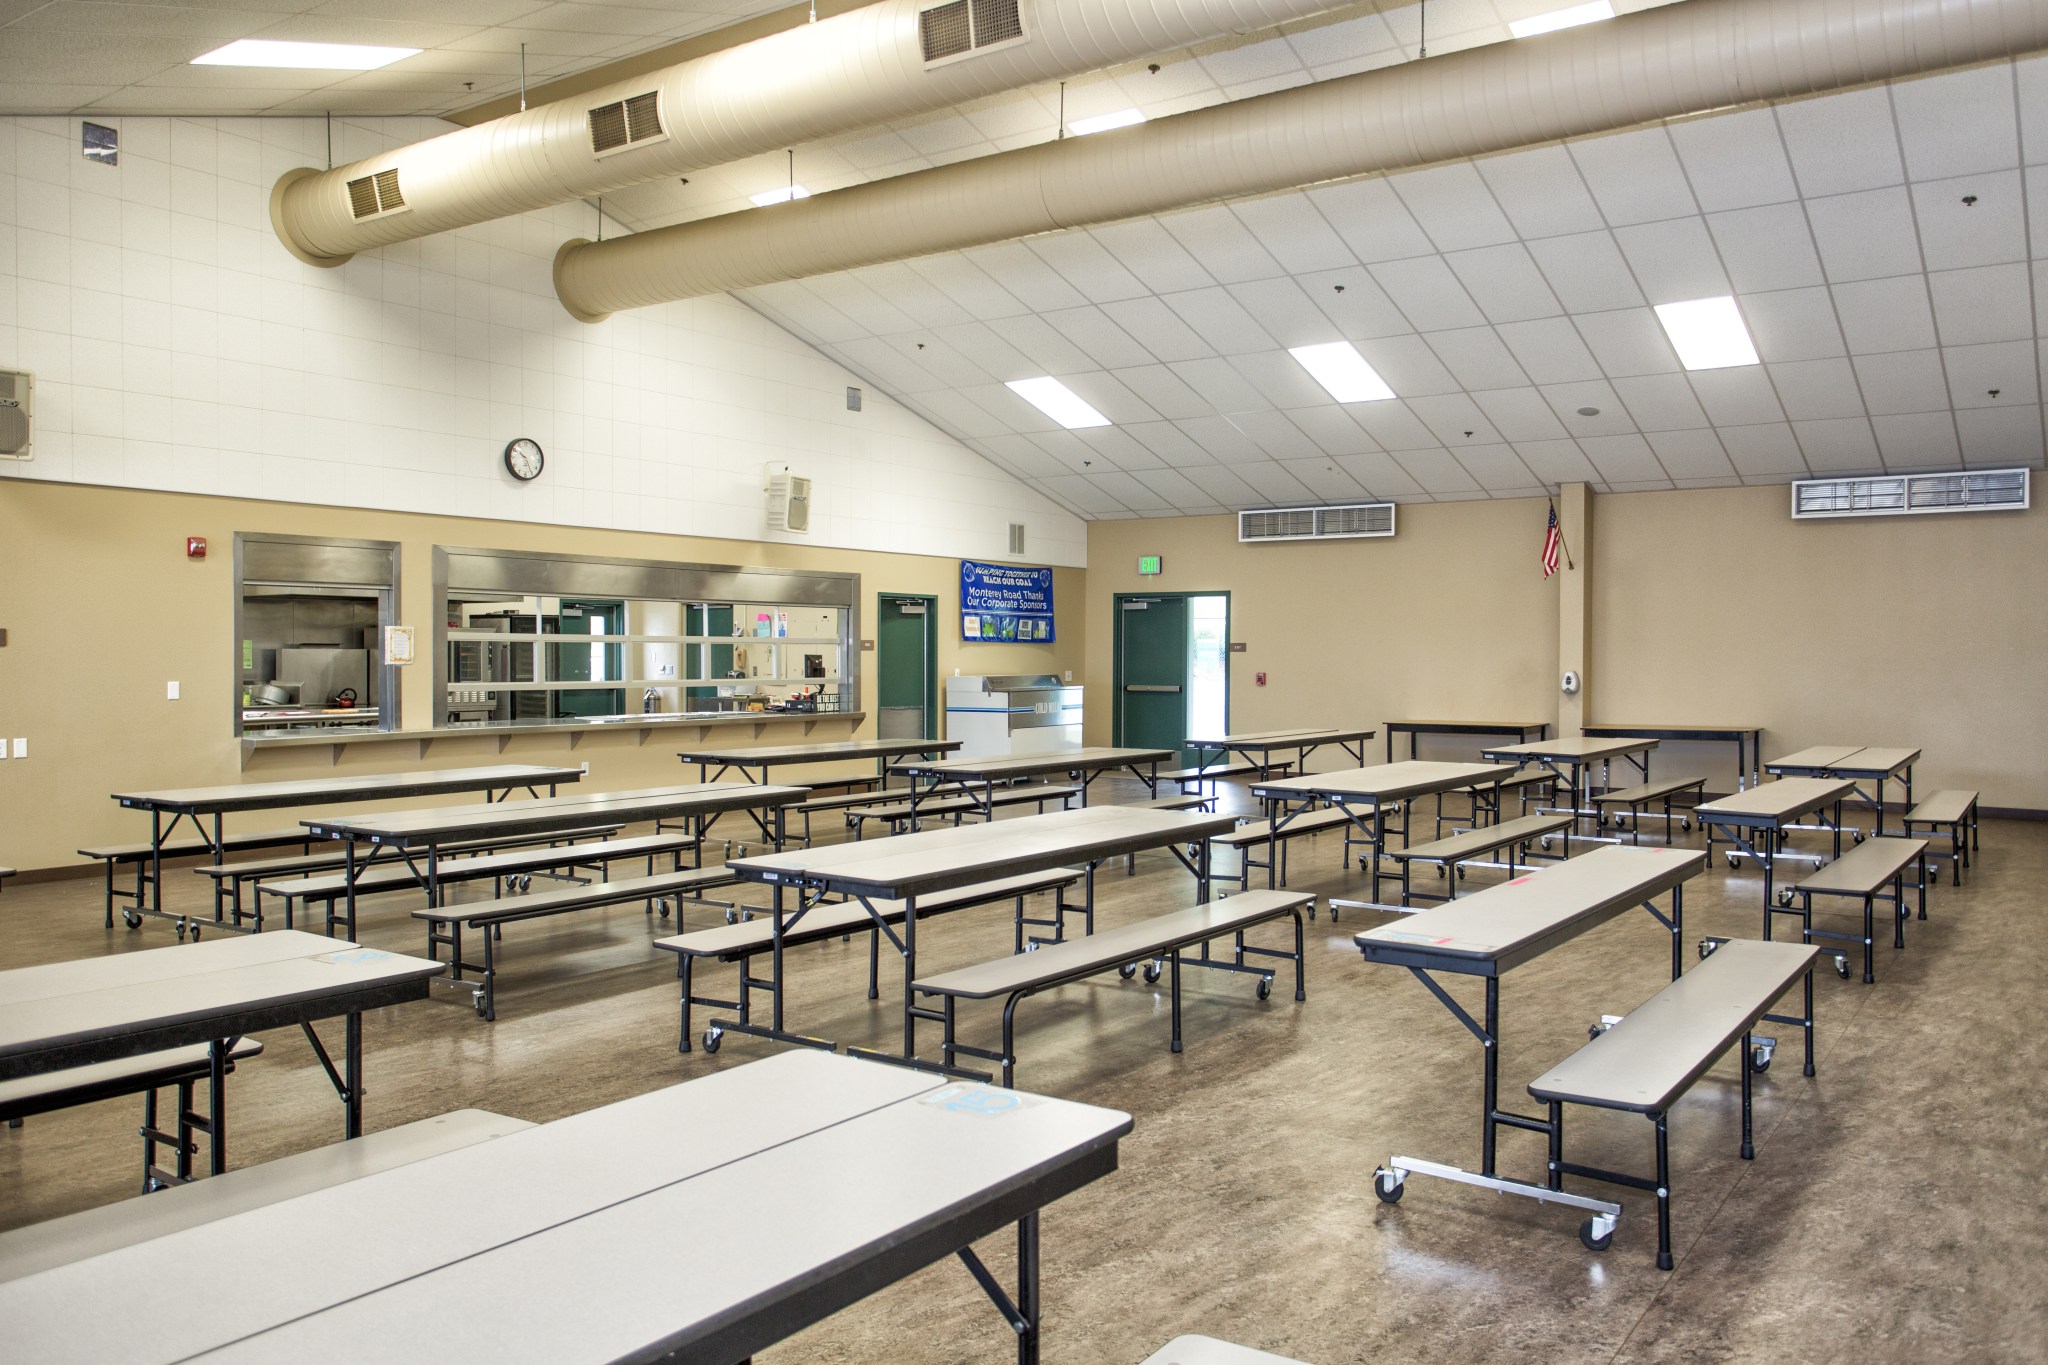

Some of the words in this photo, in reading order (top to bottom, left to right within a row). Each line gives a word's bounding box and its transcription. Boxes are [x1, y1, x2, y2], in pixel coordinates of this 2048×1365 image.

[1141, 557, 1157, 572] EXIT
[969, 587, 1001, 599] Monterey
[1003, 590, 1021, 599] Road
[1023, 591, 1044, 600] Thanks
[967, 596, 979, 605] Our
[981, 597, 1018, 608] Corporate
[1019, 600, 1047, 610] Sponsors
[1035, 702, 1048, 714] COLD
[1048, 701, 1061, 713] MIL
